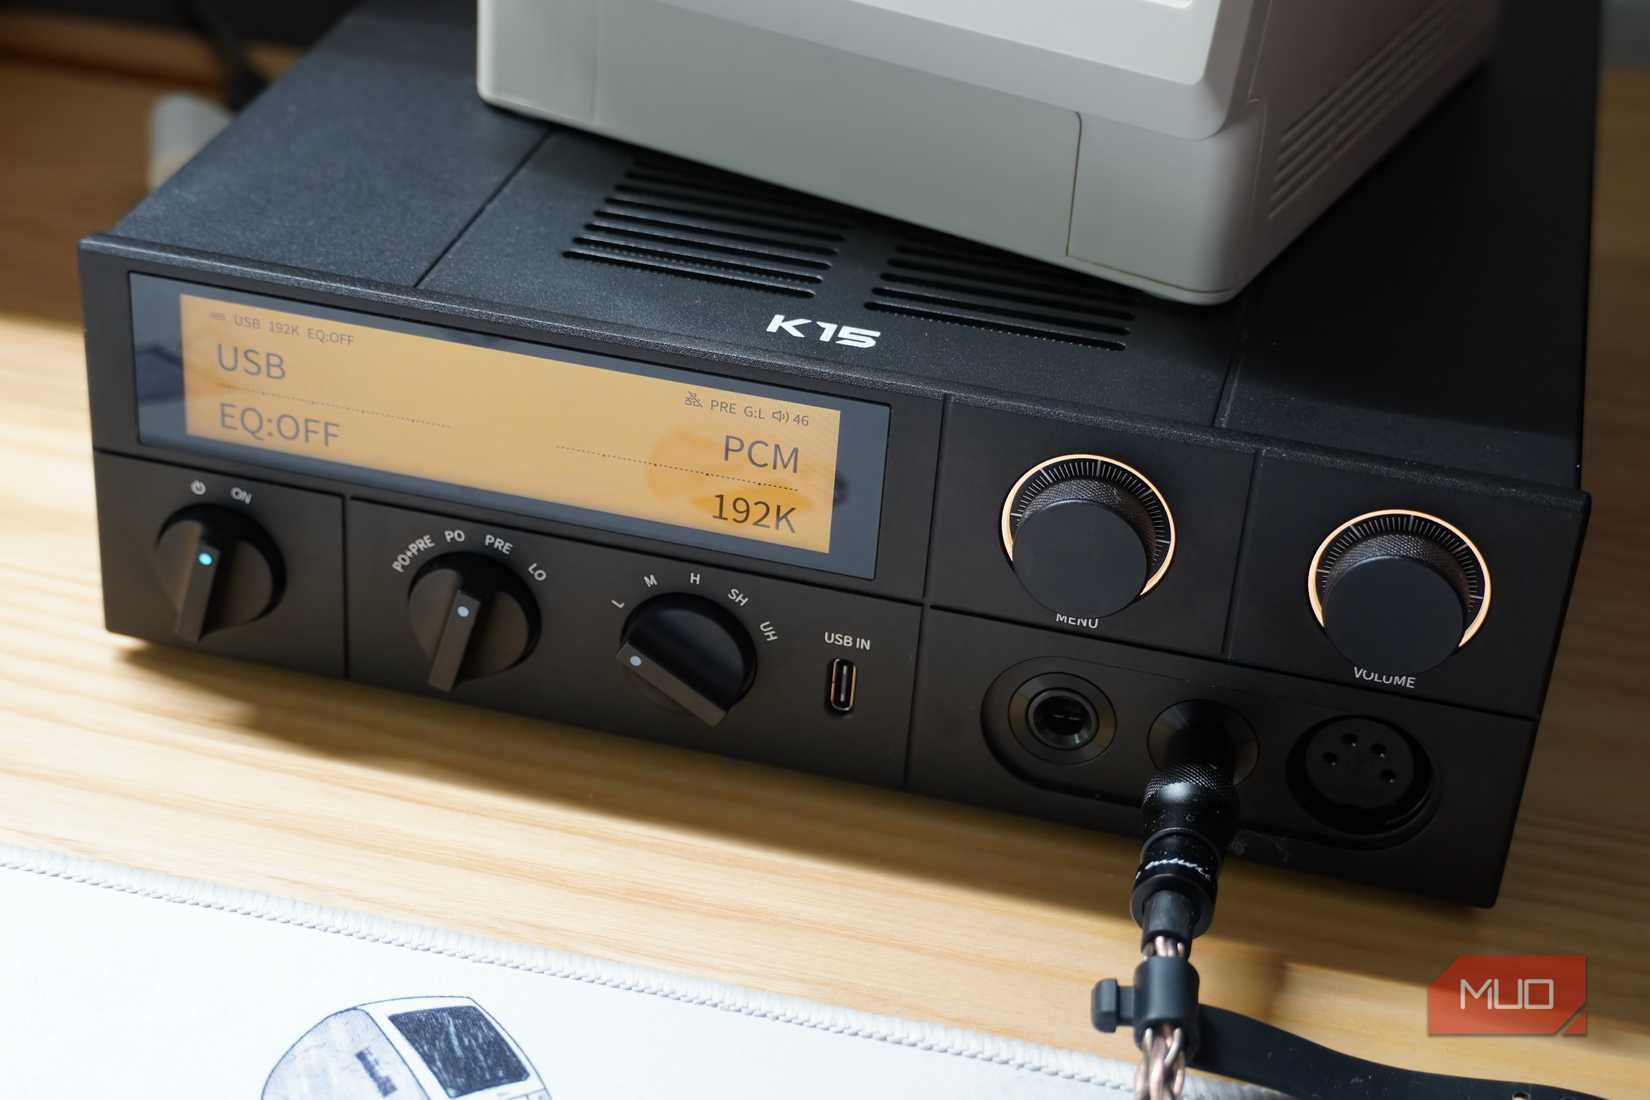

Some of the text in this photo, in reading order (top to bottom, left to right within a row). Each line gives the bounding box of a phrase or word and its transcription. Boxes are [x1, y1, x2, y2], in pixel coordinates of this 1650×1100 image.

[234, 315, 355, 346] USB 192K EQ:OFF
[766, 314, 881, 348] K15
[217, 343, 286, 380] USB
[710, 399, 810, 426] PRE G:L 46
[219, 403, 341, 447] EQ:OFF
[723, 434, 800, 474] PCM
[230, 487, 253, 505] ON
[711, 493, 797, 534] 192K
[444, 529, 466, 543] PO
[484, 534, 514, 555] PRE
[392, 534, 436, 573] PO+PRE
[527, 562, 548, 582] LO
[643, 573, 659, 588] M
[689, 572, 701, 585] H
[611, 599, 625, 608] L
[727, 588, 749, 607] SH
[759, 620, 779, 643] UH
[1055, 612, 1099, 629] MENU
[824, 631, 871, 650] USB IN
[1353, 666, 1417, 689] VOLUME
